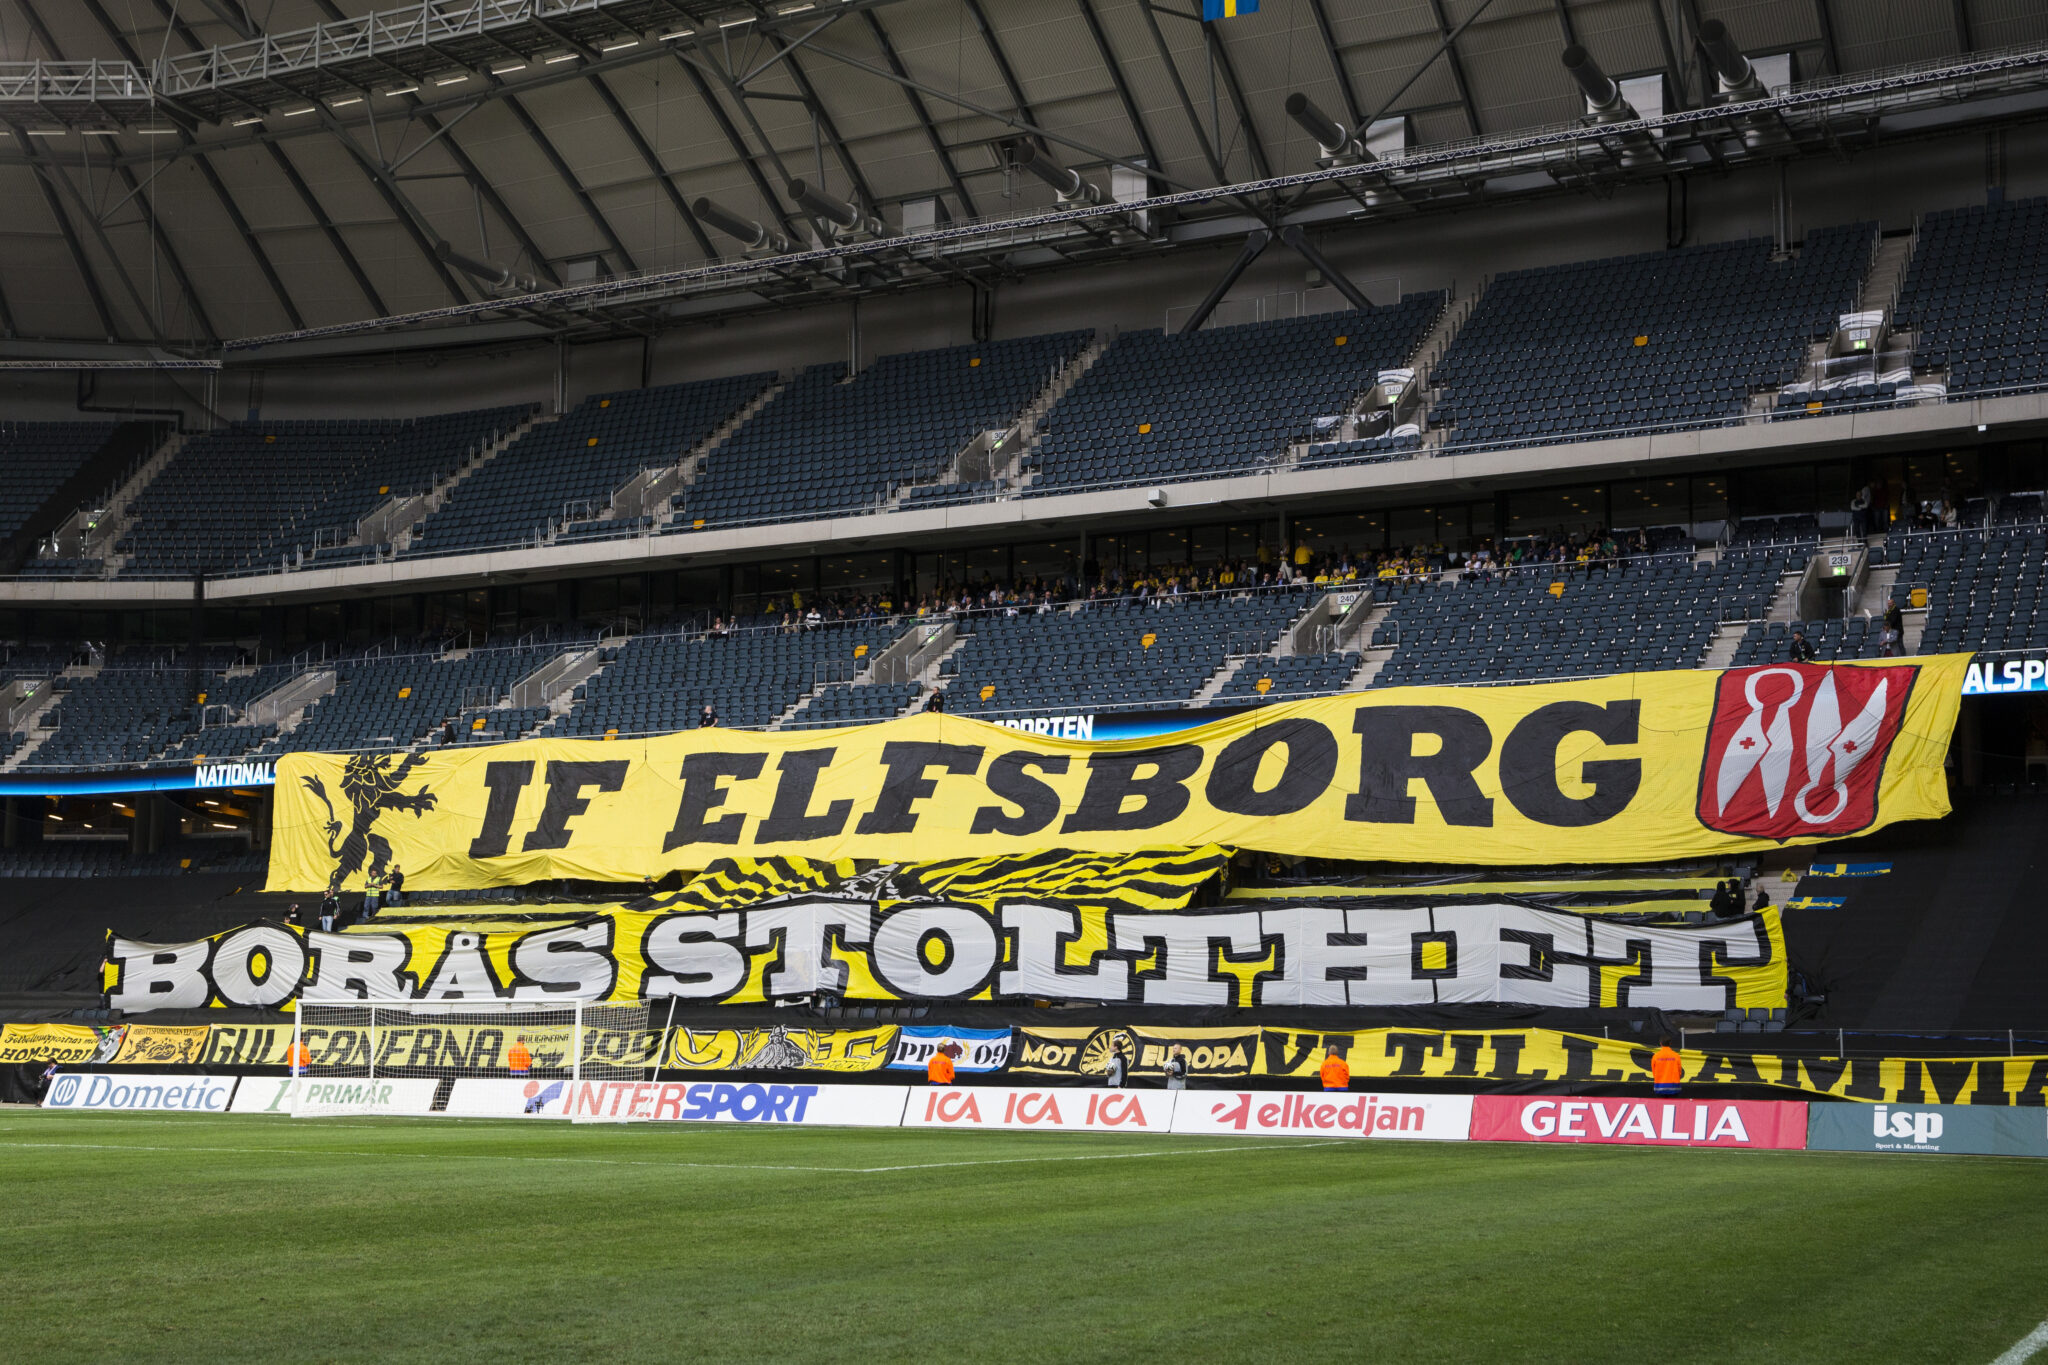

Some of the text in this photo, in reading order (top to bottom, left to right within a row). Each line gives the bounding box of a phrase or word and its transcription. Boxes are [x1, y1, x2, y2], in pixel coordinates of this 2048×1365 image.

[1831, 556, 1849, 565] 239
[1340, 595, 1354, 603] 240
[1961, 659, 2048, 693] ALSP
[195, 762, 276, 787] NATIONAL
[468, 699, 1642, 859] IF ELFSBORG
[105, 898, 1772, 1014] BORÅS STOLTHET
[897, 1041, 935, 1063] PP
[973, 1043, 1008, 1067] 09
[1021, 1042, 1078, 1067] MOT
[1260, 1030, 1355, 1077] VI
[82, 1075, 226, 1110] Dometic
[562, 1080, 819, 1122] INTERSPORT
[924, 1092, 1148, 1127] ICA ICA ICA
[1257, 1094, 1426, 1137] elkedjan
[1520, 1101, 1750, 1142] GEVALIA
[1873, 1105, 1944, 1143] isp
[1875, 1142, 1894, 1150] Sport
[1903, 1142, 1940, 1151] Marketing
